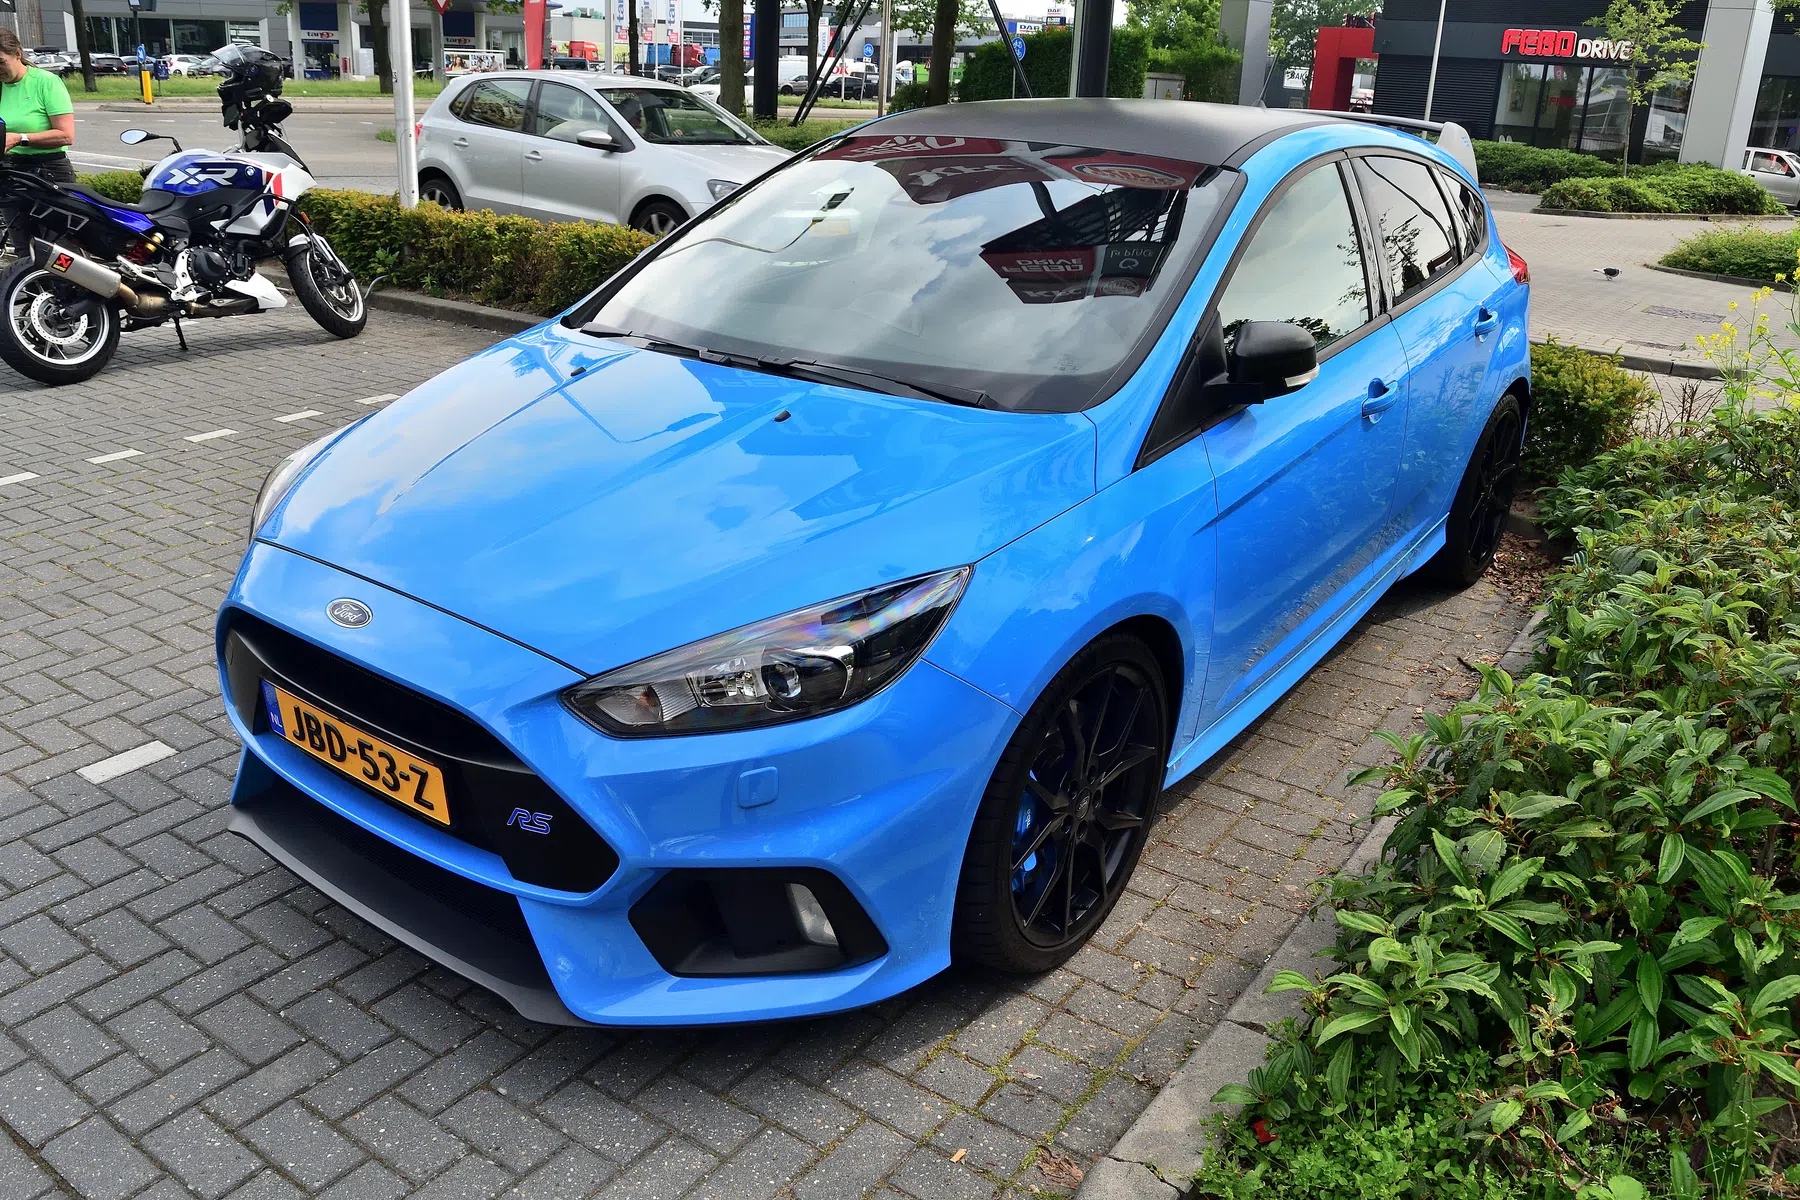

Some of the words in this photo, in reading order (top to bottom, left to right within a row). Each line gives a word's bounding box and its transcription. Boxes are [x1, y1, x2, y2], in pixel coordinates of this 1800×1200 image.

[1501, 28, 1577, 58] FEBO
[1576, 38, 1634, 60] DRIVE
[164, 167, 238, 186] XR
[334, 603, 362, 622] Ford
[270, 711, 283, 728] NL
[292, 704, 435, 811] JBD-53-Z
[506, 807, 553, 835] RS
